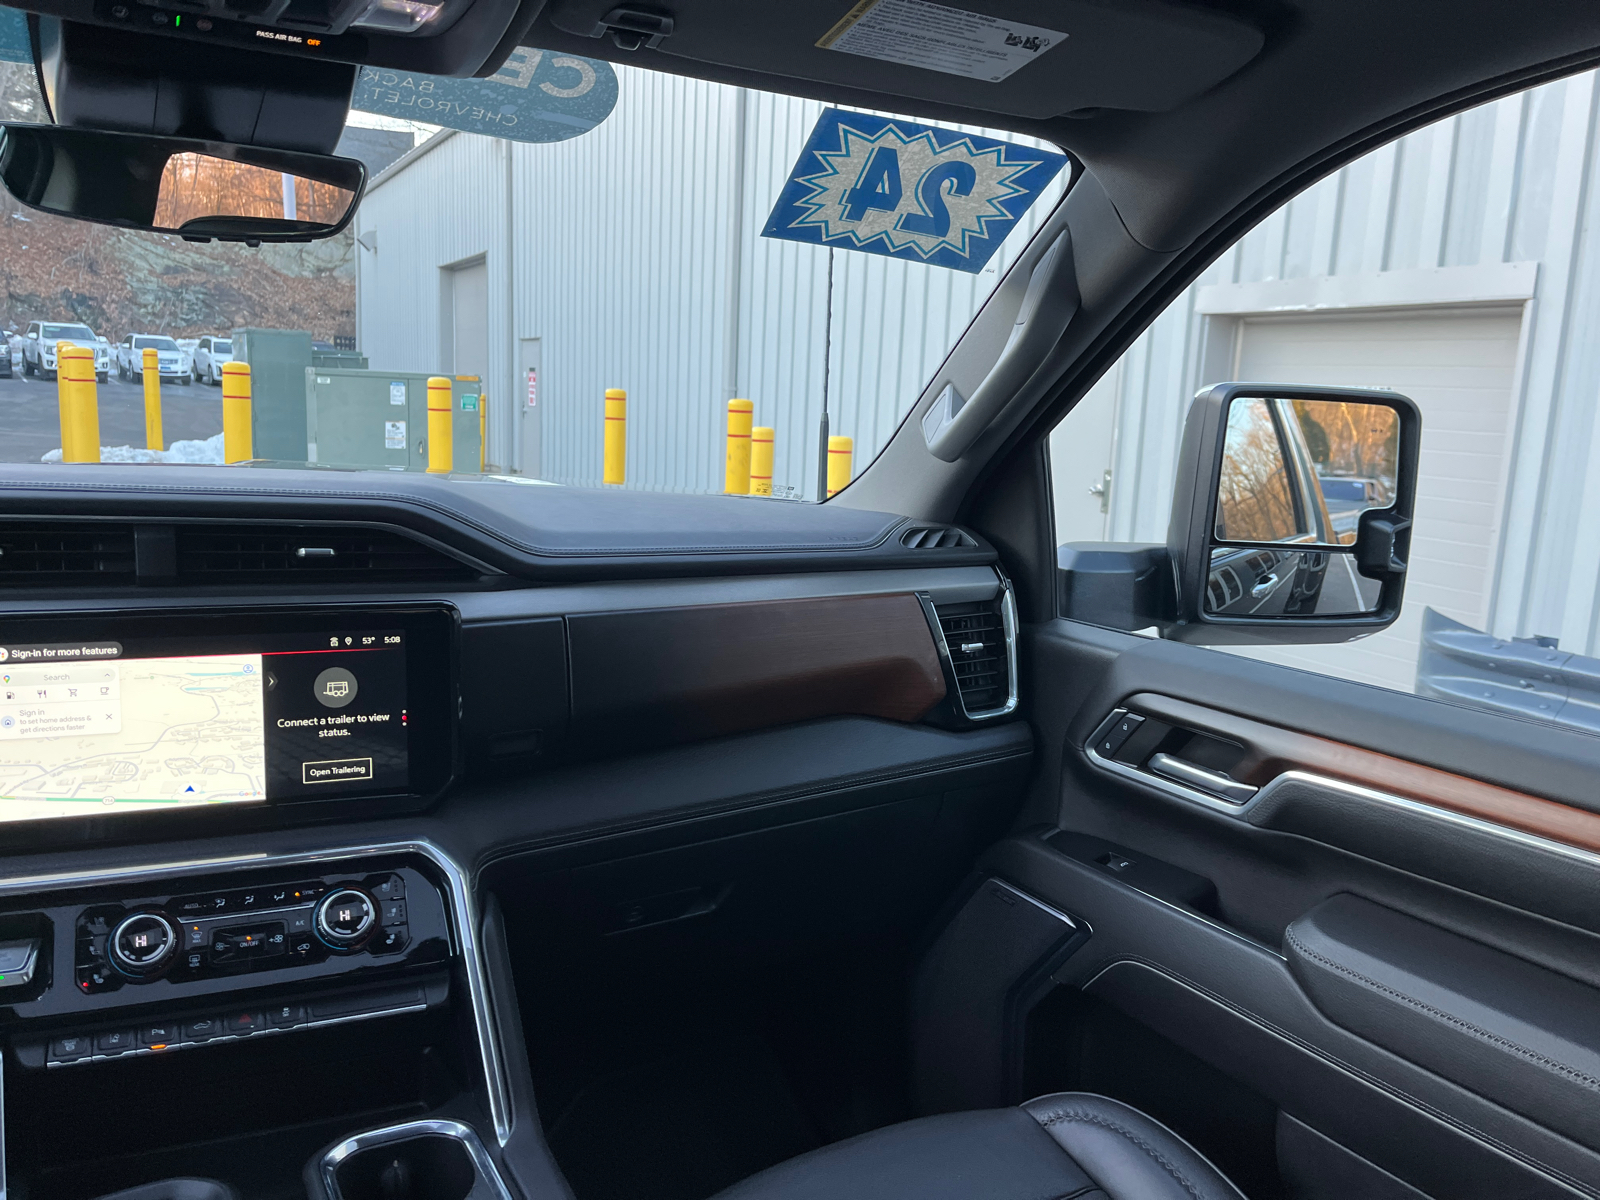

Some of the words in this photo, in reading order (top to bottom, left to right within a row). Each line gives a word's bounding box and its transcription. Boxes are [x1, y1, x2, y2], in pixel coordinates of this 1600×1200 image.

[256, 30, 274, 40] PASS
[275, 33, 287, 41] AIR
[288, 34, 302, 43] BAG
[307, 38, 321, 47] OFF
[384, 636, 400, 644] 5:08
[12, 649, 42, 660] Sign-in
[43, 648, 56, 657] for
[57, 648, 82, 656] more
[82, 647, 118, 656] features
[44, 674, 70, 682] Search
[19, 710, 36, 718] Sign
[277, 717, 318, 728] Connect
[328, 714, 355, 724] trailer
[368, 713, 390, 722] view
[20, 726, 31, 734] get
[32, 725, 65, 733] directions
[318, 728, 351, 738] status.
[310, 768, 330, 777] Open
[331, 766, 366, 774] Trailering
[340, 910, 350, 922] HI
[135, 934, 147, 948] HI
